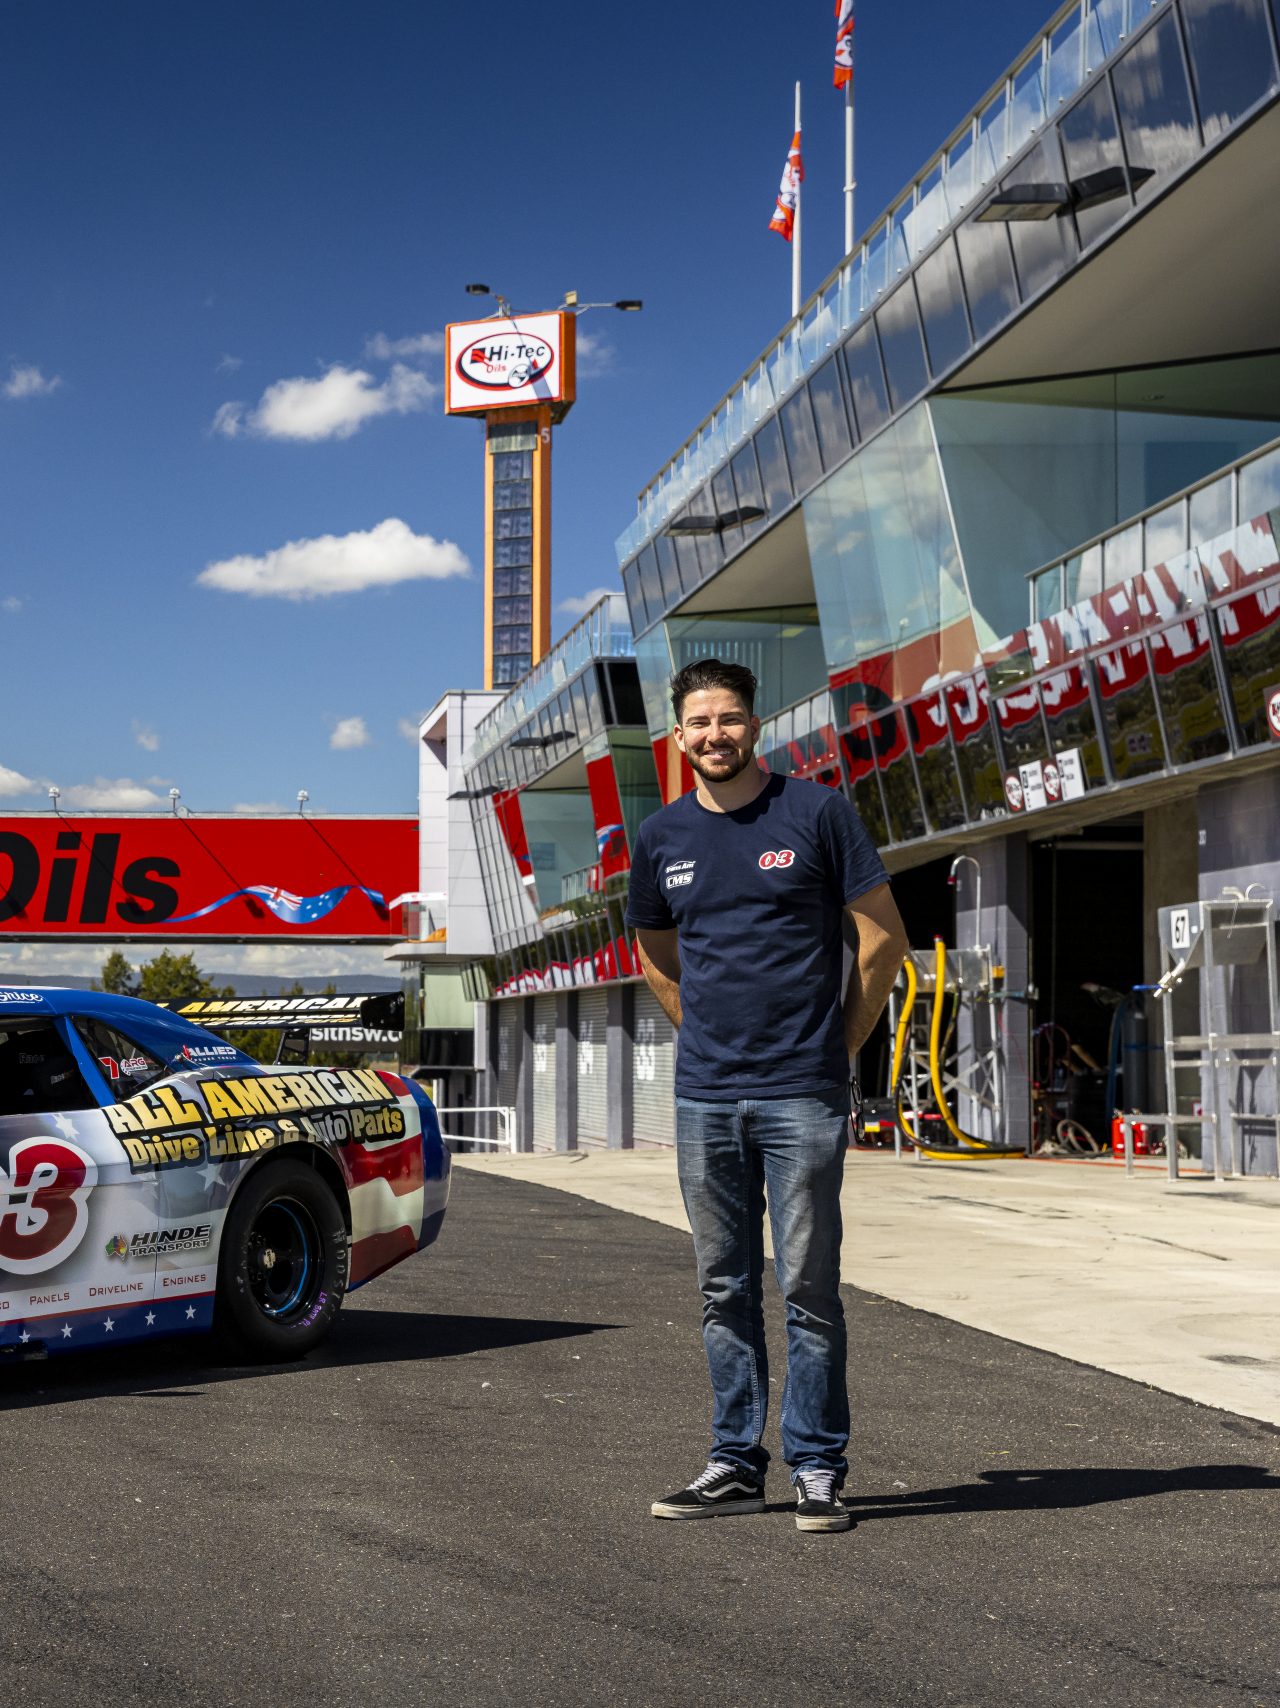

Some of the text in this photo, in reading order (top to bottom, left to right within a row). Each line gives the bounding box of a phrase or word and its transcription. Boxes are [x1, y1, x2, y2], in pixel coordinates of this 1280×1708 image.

[489, 344, 546, 361] Hi-Tec
[486, 363, 507, 373] Oils
[759, 849, 795, 870] 03
[667, 873, 693, 888] CMS
[1174, 915, 1186, 944] 67
[186, 1046, 237, 1057] ALLIED
[124, 1058, 146, 1067] ARG
[109, 1069, 394, 1133] ALL AMERICAN
[123, 1107, 404, 1167] Drive Line & Auto Parts
[129, 1236, 210, 1256] TRANSPORT
[130, 1225, 212, 1248] HINDE
[29, 1290, 70, 1306] PANELS
[89, 1281, 144, 1298] DRIVELINE
[162, 1272, 207, 1288] ENGINES
